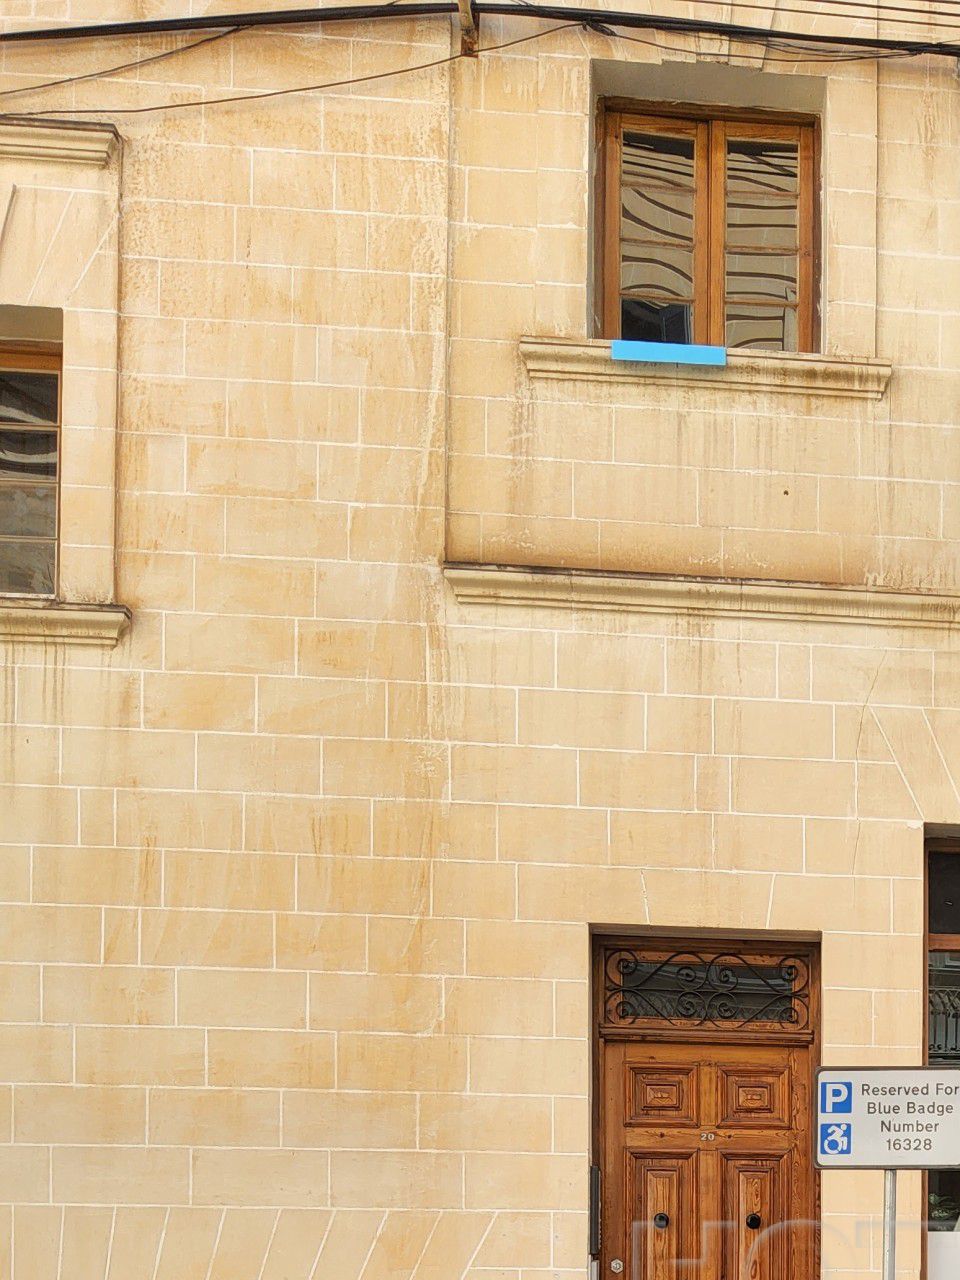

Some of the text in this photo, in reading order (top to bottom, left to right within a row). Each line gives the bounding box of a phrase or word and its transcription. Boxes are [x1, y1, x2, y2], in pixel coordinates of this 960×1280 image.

[861, 1083, 960, 1096] Reserved For
[867, 1102, 954, 1116] Blue Badge
[880, 1120, 940, 1133] Number
[886, 1138, 932, 1151] 16328
